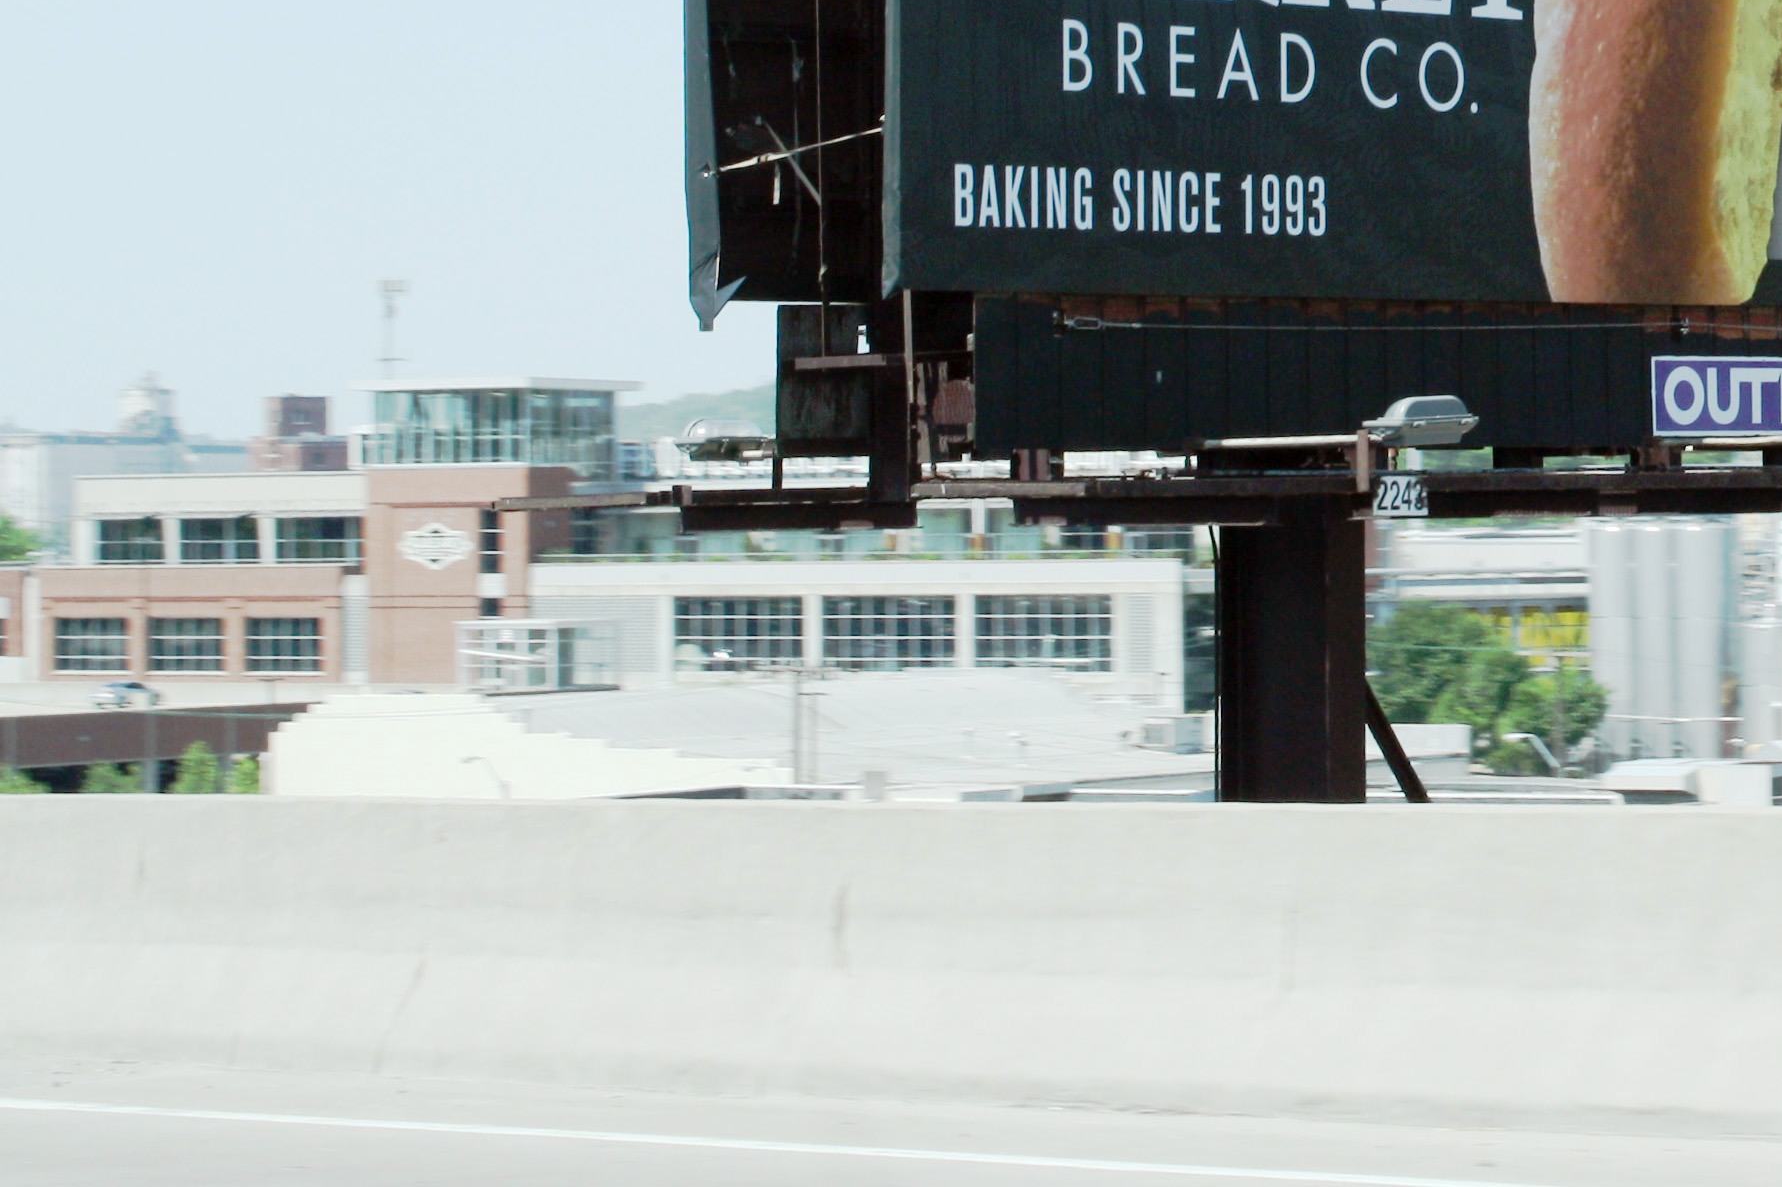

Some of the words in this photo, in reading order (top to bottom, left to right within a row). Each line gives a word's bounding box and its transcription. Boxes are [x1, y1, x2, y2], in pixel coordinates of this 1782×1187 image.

[1062, 19, 1316, 103] BREAD
[1360, 38, 1478, 114] CO.
[954, 163, 1093, 230] BAKING
[1112, 168, 1221, 233] SINCE
[1241, 174, 1327, 237] 1993
